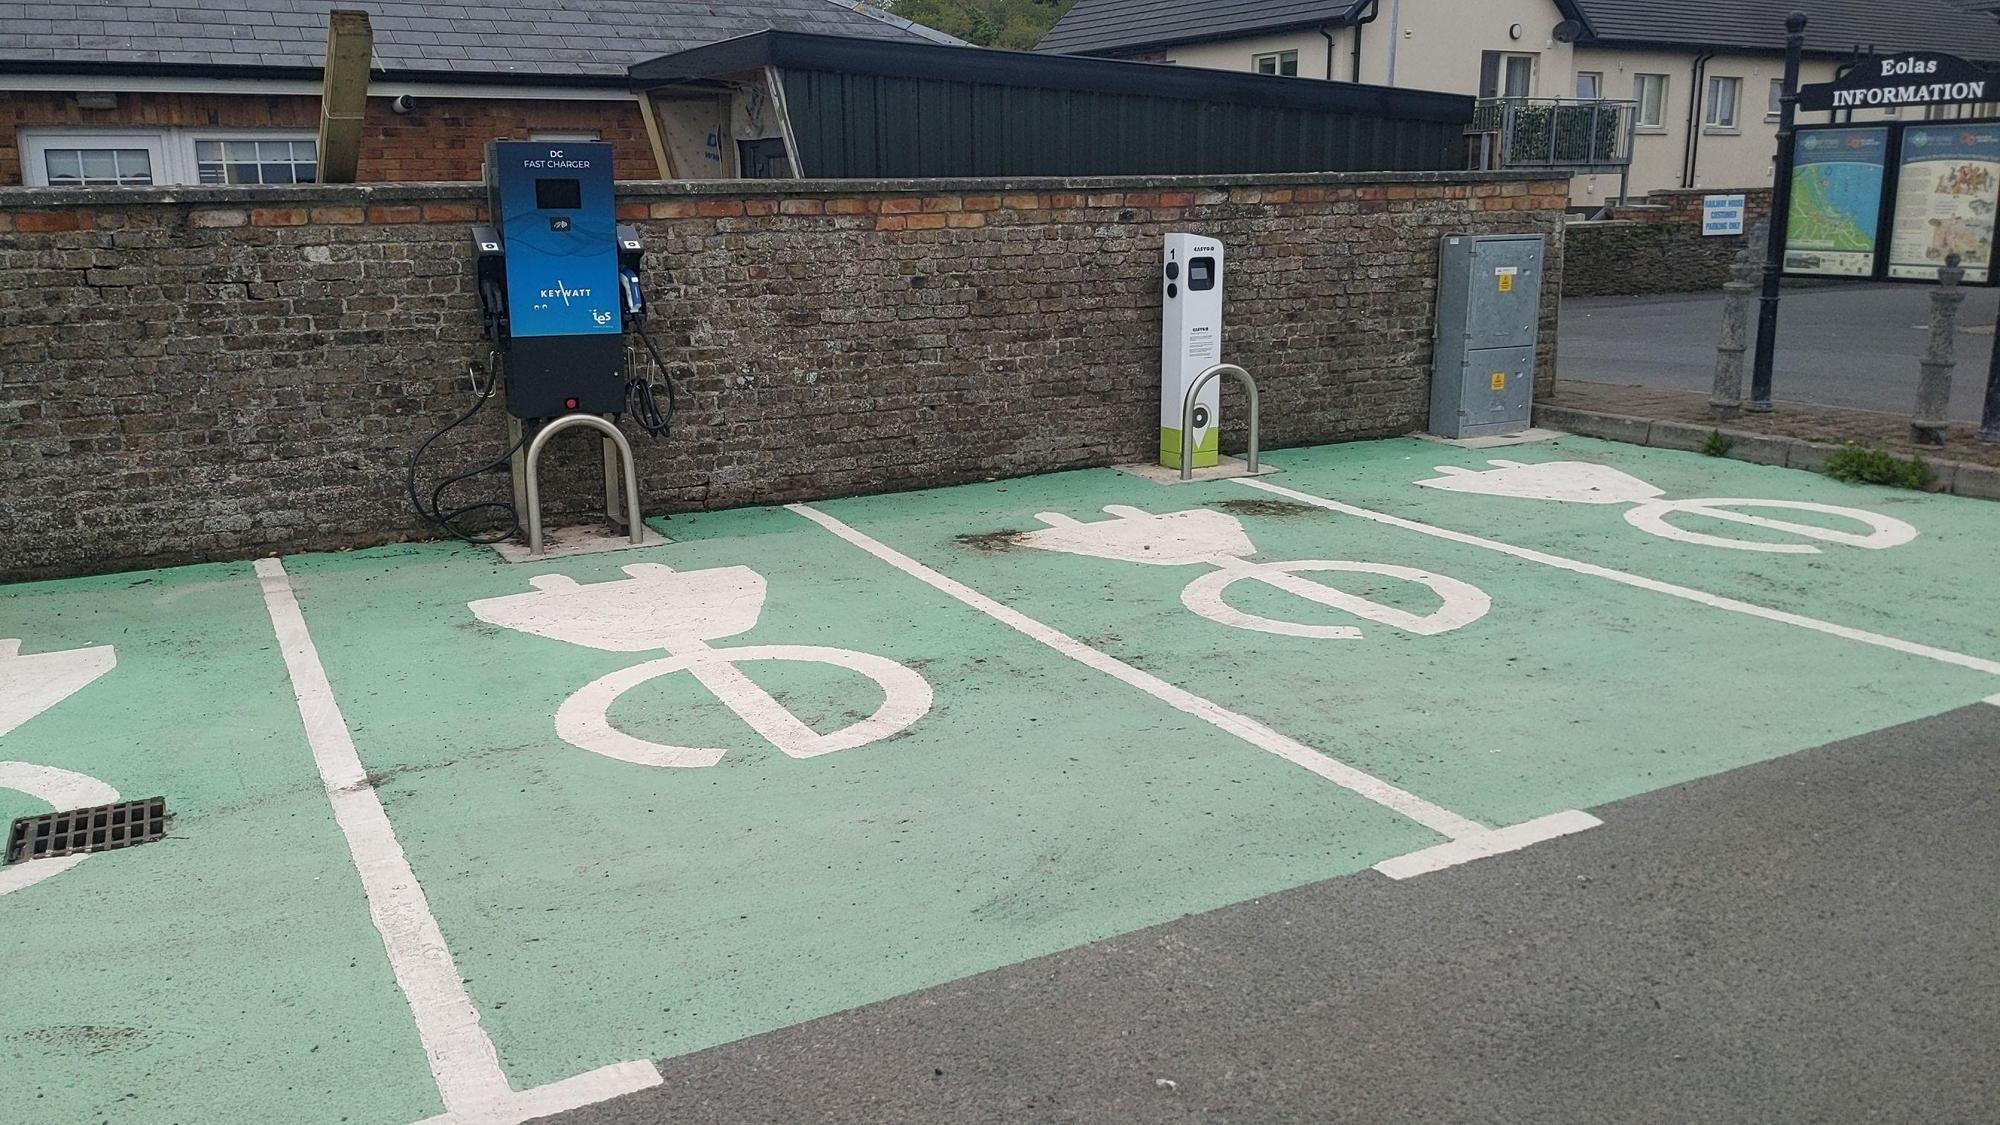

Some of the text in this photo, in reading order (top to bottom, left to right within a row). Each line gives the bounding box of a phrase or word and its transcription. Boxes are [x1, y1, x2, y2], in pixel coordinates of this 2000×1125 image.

[1881, 57, 1937, 76] Eolas
[1832, 81, 1985, 106] INFORMATION
[550, 150, 564, 158] DC
[524, 160, 590, 169] FAST CHARGER
[1705, 222, 1727, 230] PARKING
[1170, 248, 1175, 260] 1
[540, 288, 591, 298] KEYWATT
[592, 309, 611, 324] ies
